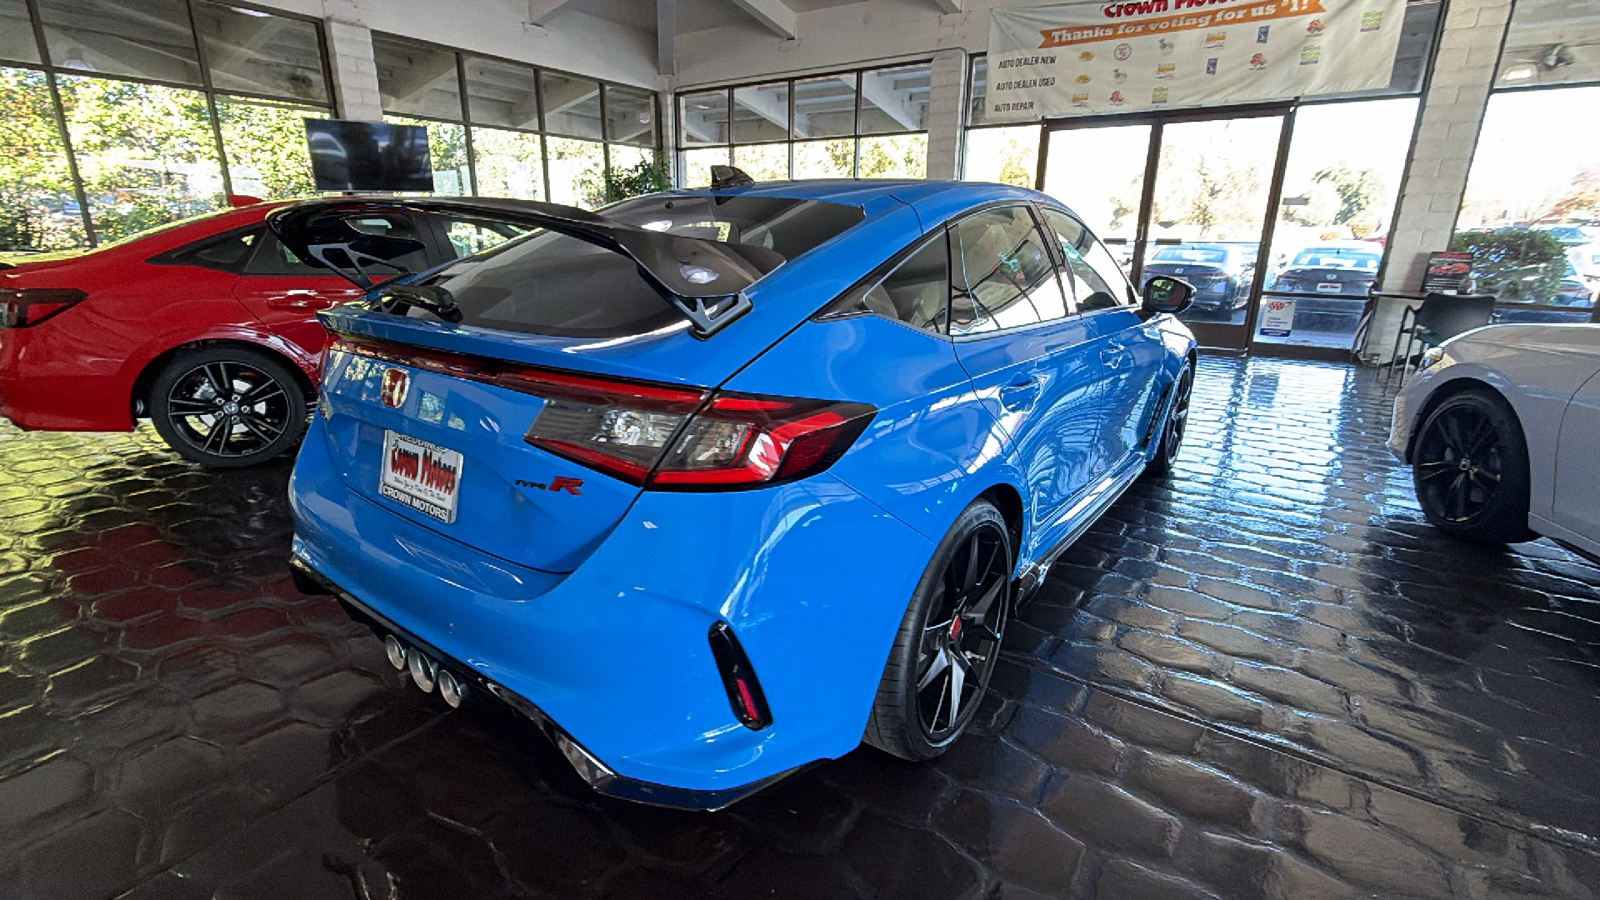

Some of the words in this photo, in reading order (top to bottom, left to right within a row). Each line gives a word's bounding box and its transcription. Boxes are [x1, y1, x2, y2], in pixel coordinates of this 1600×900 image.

[1104, 0, 1168, 18] Crown
[1052, 24, 1113, 43] Thanks
[1116, 23, 1145, 35] for
[1149, 15, 1212, 29] voting
[1214, 8, 1247, 22] for
[1251, 4, 1276, 16] us
[998, 59, 1014, 69] AUTO
[1015, 57, 1039, 67] DEALER
[1040, 55, 1057, 64] NEW
[996, 81, 1013, 91] AUTO
[1013, 79, 1037, 89] DEALER
[1038, 77, 1055, 87] USED
[994, 103, 1011, 112] AUTO
[1011, 101, 1034, 111] REPAIR
[548, 476, 584, 496] R
[382, 485, 411, 506] CROWN
[412, 497, 447, 519] MOTORS
